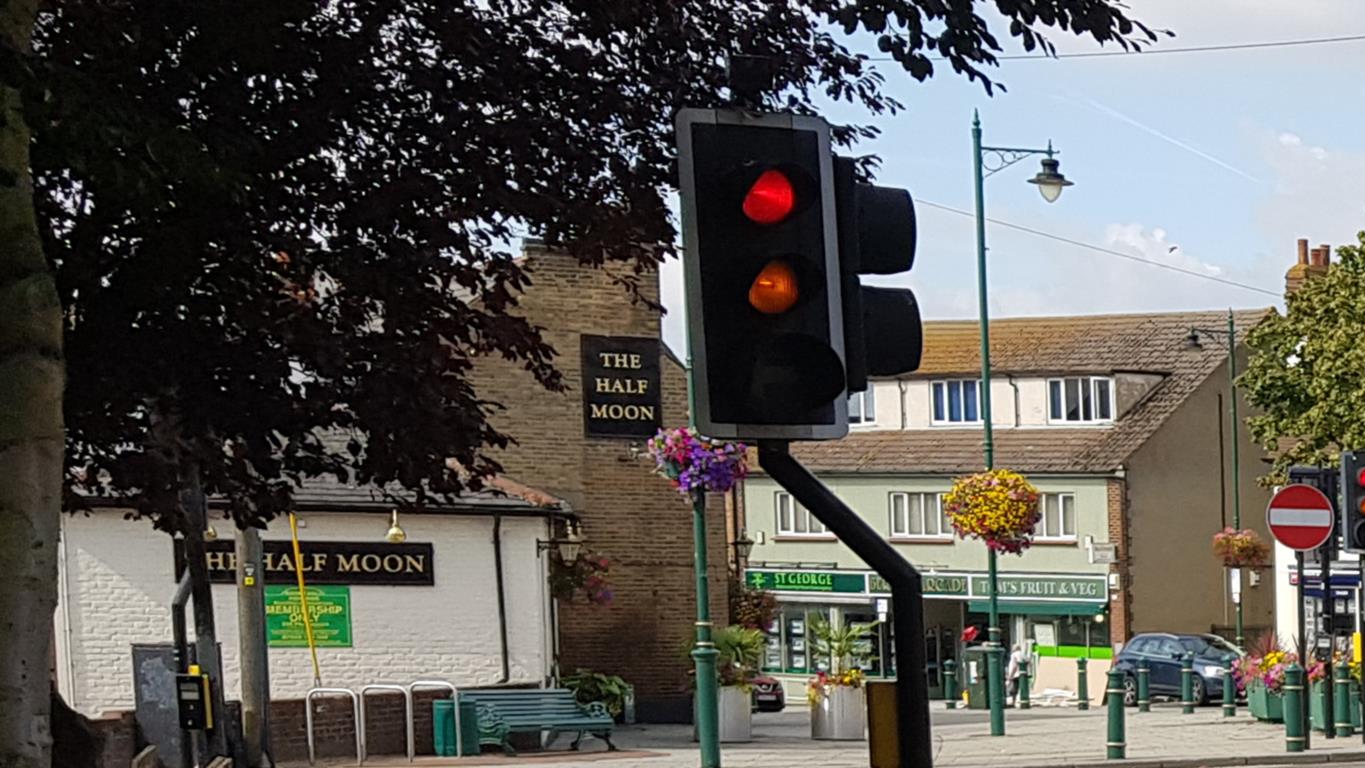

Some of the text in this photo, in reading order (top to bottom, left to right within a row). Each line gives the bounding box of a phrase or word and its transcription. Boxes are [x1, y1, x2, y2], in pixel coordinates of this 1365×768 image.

[600, 352, 642, 369] THE
[595, 377, 648, 394] HALF
[590, 403, 655, 420] MOON
[205, 551, 425, 573] HE HALF MOON
[774, 572, 832, 585] ST GEORGE
[922, 577, 967, 592] RCADE
[980, 580, 1096, 595] TM'S FRUIT & VEG
